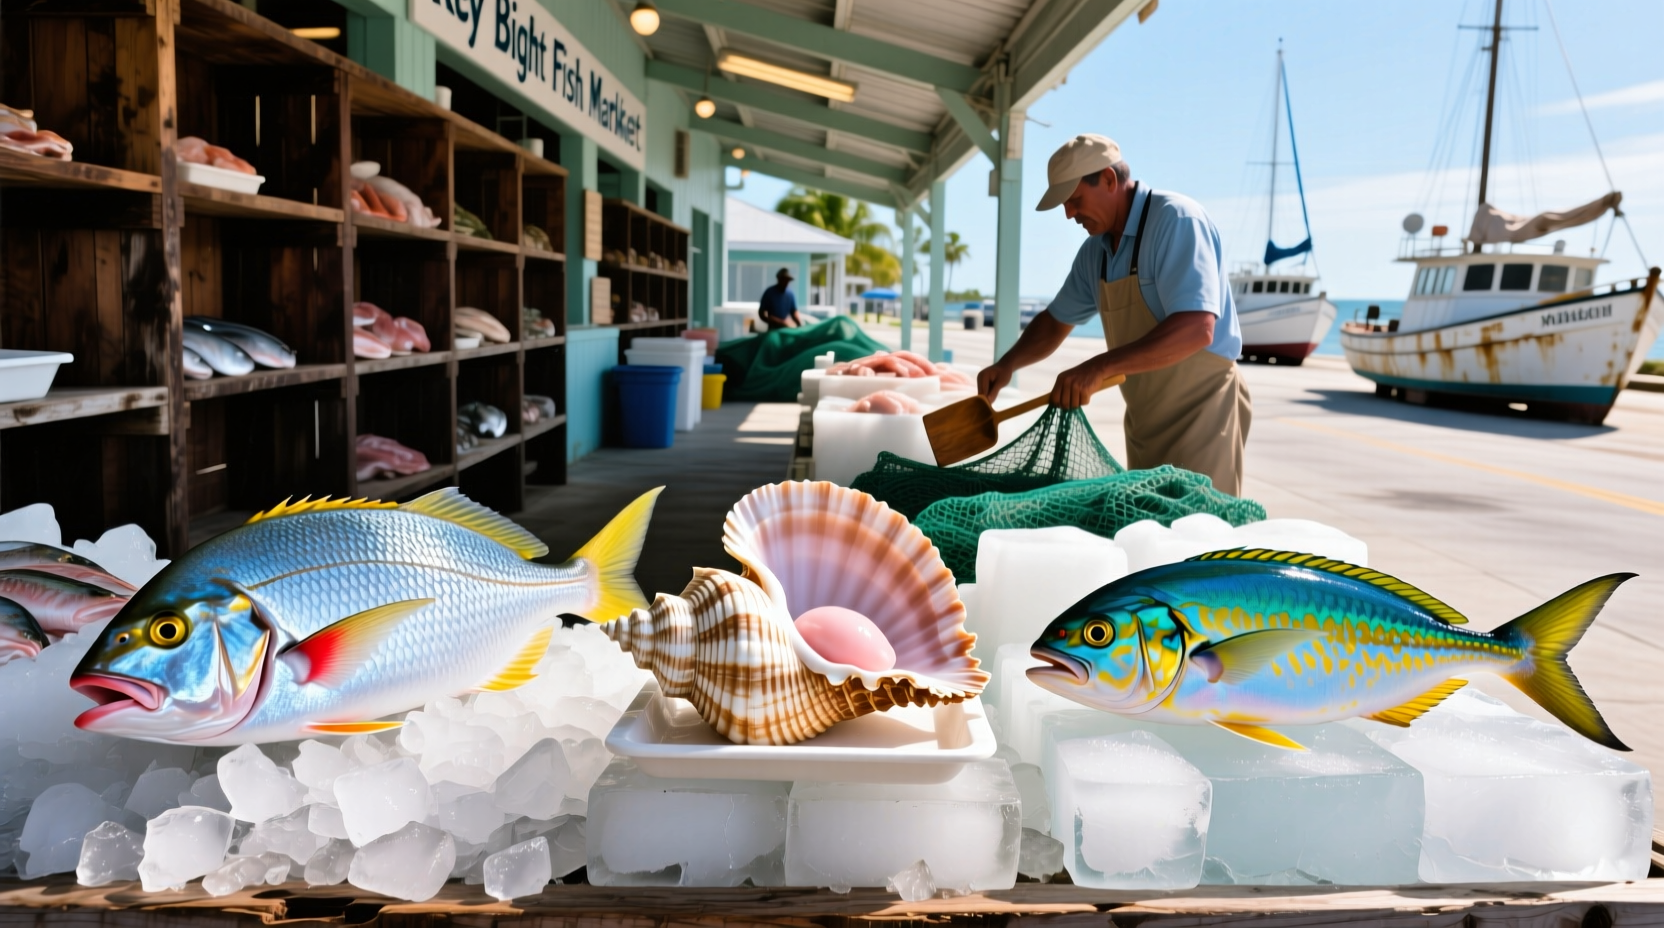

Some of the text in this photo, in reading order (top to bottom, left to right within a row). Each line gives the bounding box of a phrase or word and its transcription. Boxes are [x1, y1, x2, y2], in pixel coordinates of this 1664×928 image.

[432, 0, 484, 48] ey
[495, 0, 547, 83] Bight
[553, 38, 583, 112] Fish
